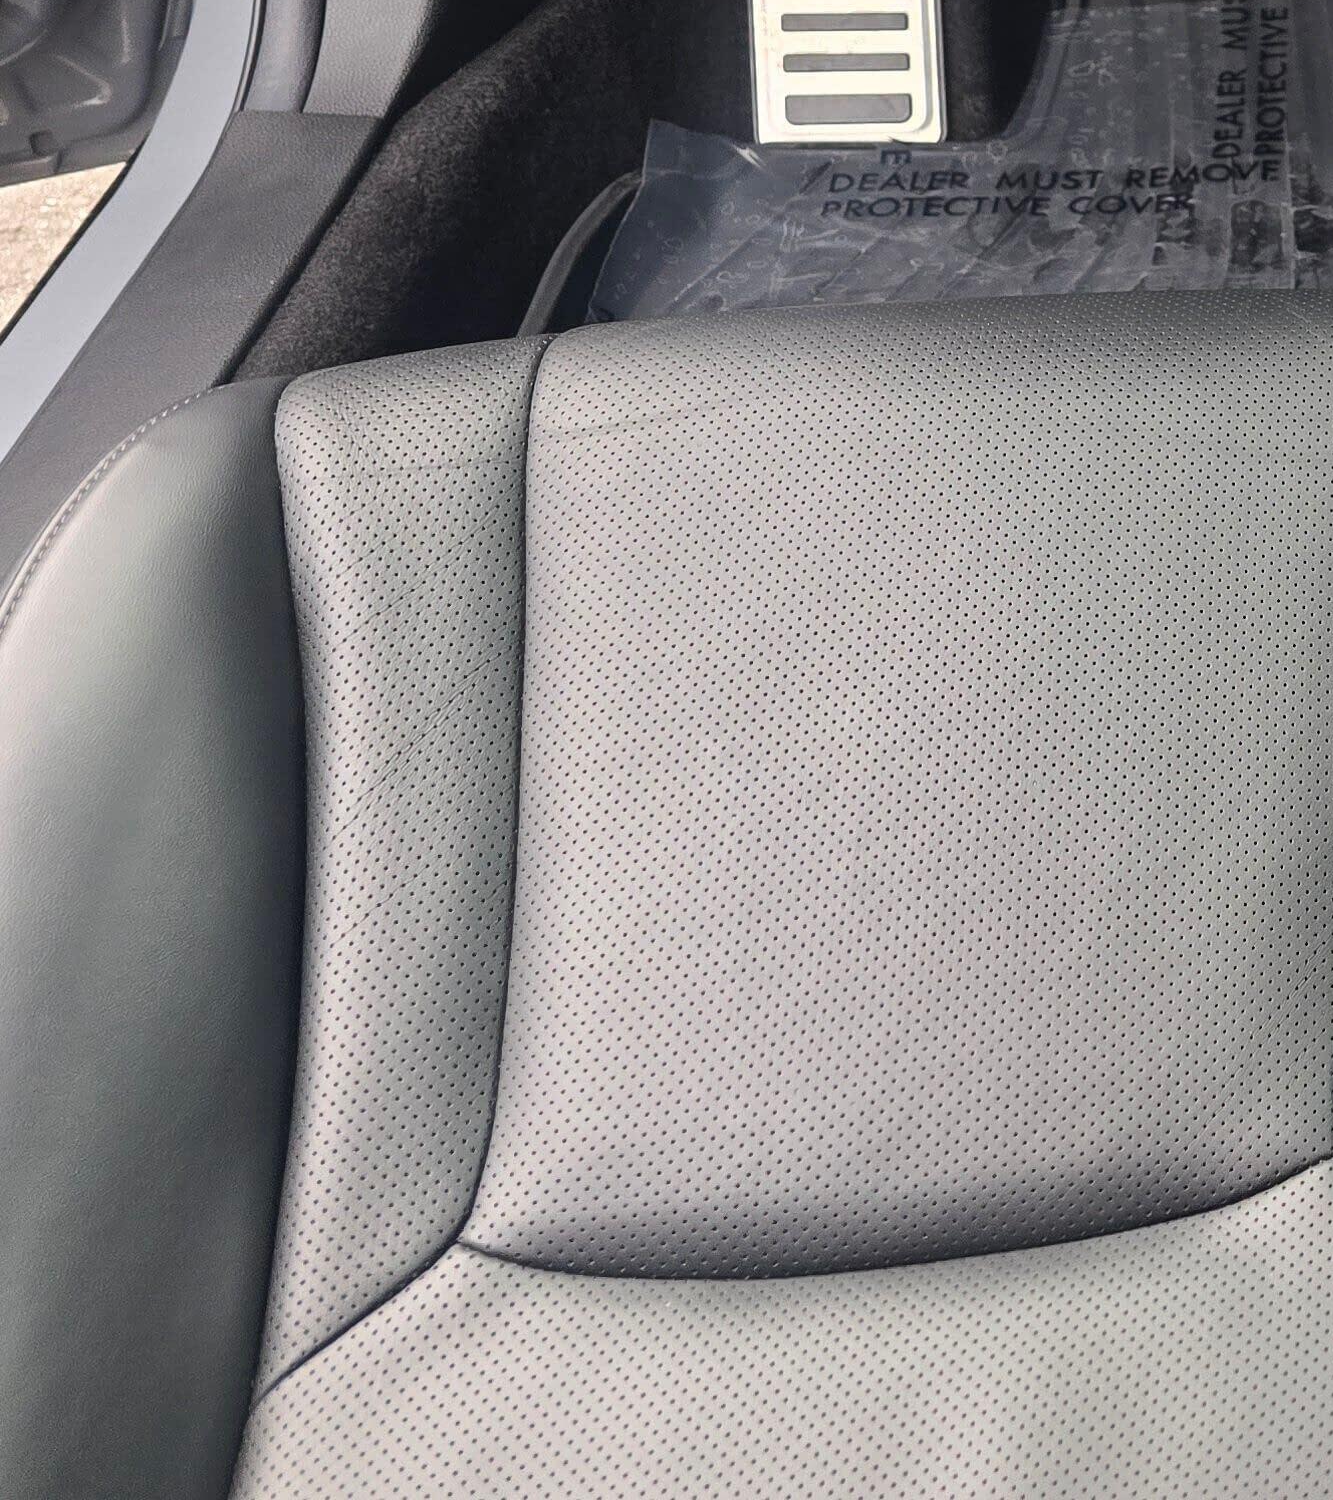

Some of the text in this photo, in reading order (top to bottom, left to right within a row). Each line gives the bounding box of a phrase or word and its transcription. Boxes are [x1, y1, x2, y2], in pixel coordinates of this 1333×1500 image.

[1212, 67, 1247, 159] DEALER
[1253, 7, 1289, 156] PROTECTIVE
[820, 195, 1195, 218] PROTECTIVE COVER
[829, 159, 1281, 193] DEALER MUST REMOVE
